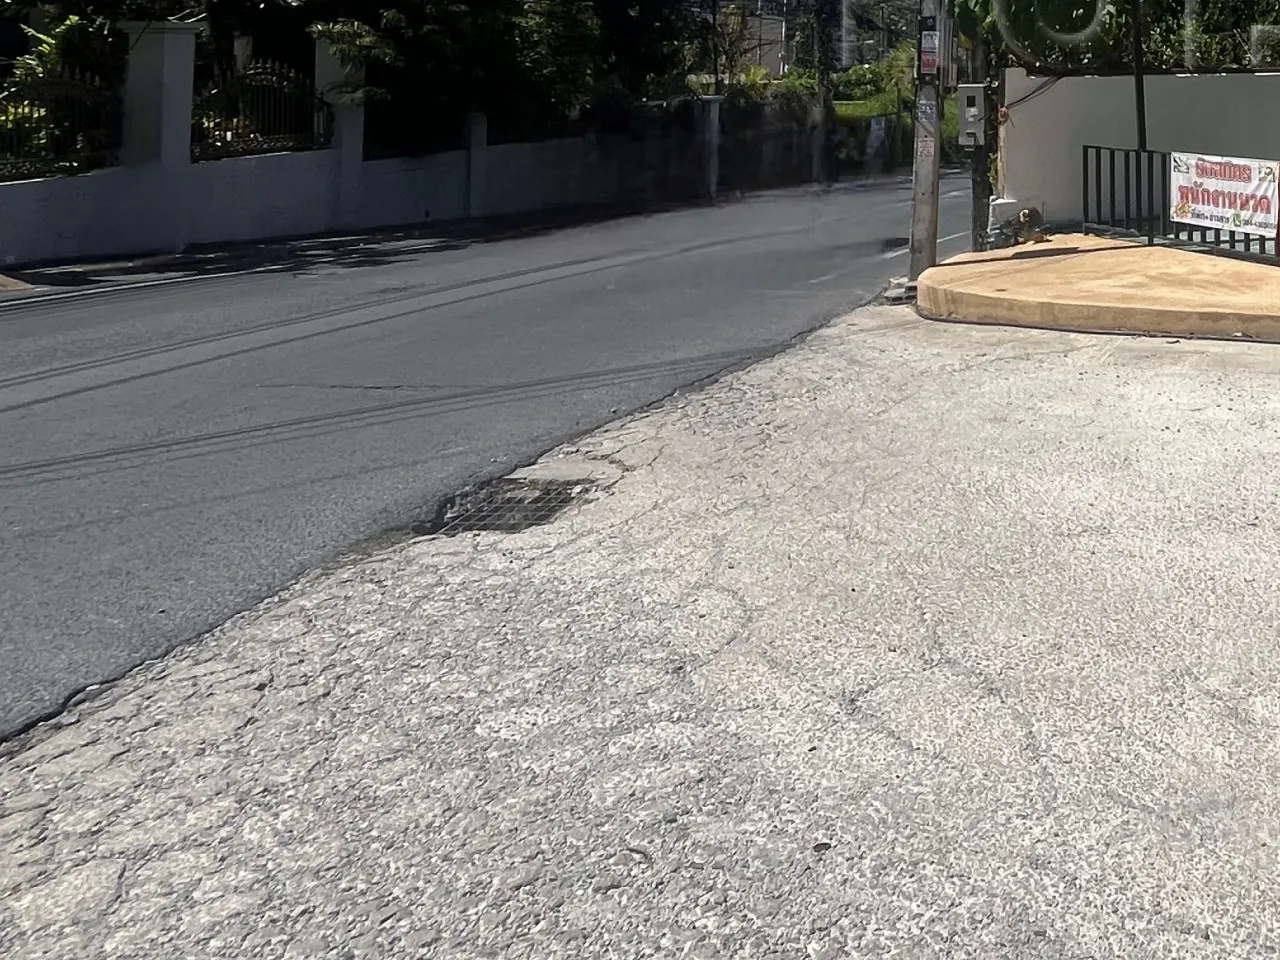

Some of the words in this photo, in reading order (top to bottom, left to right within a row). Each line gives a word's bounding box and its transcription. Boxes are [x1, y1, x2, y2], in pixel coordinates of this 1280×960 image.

[1195, 157, 1253, 184] รับสมัคร
[1178, 180, 1272, 215] พนักงานนวด
